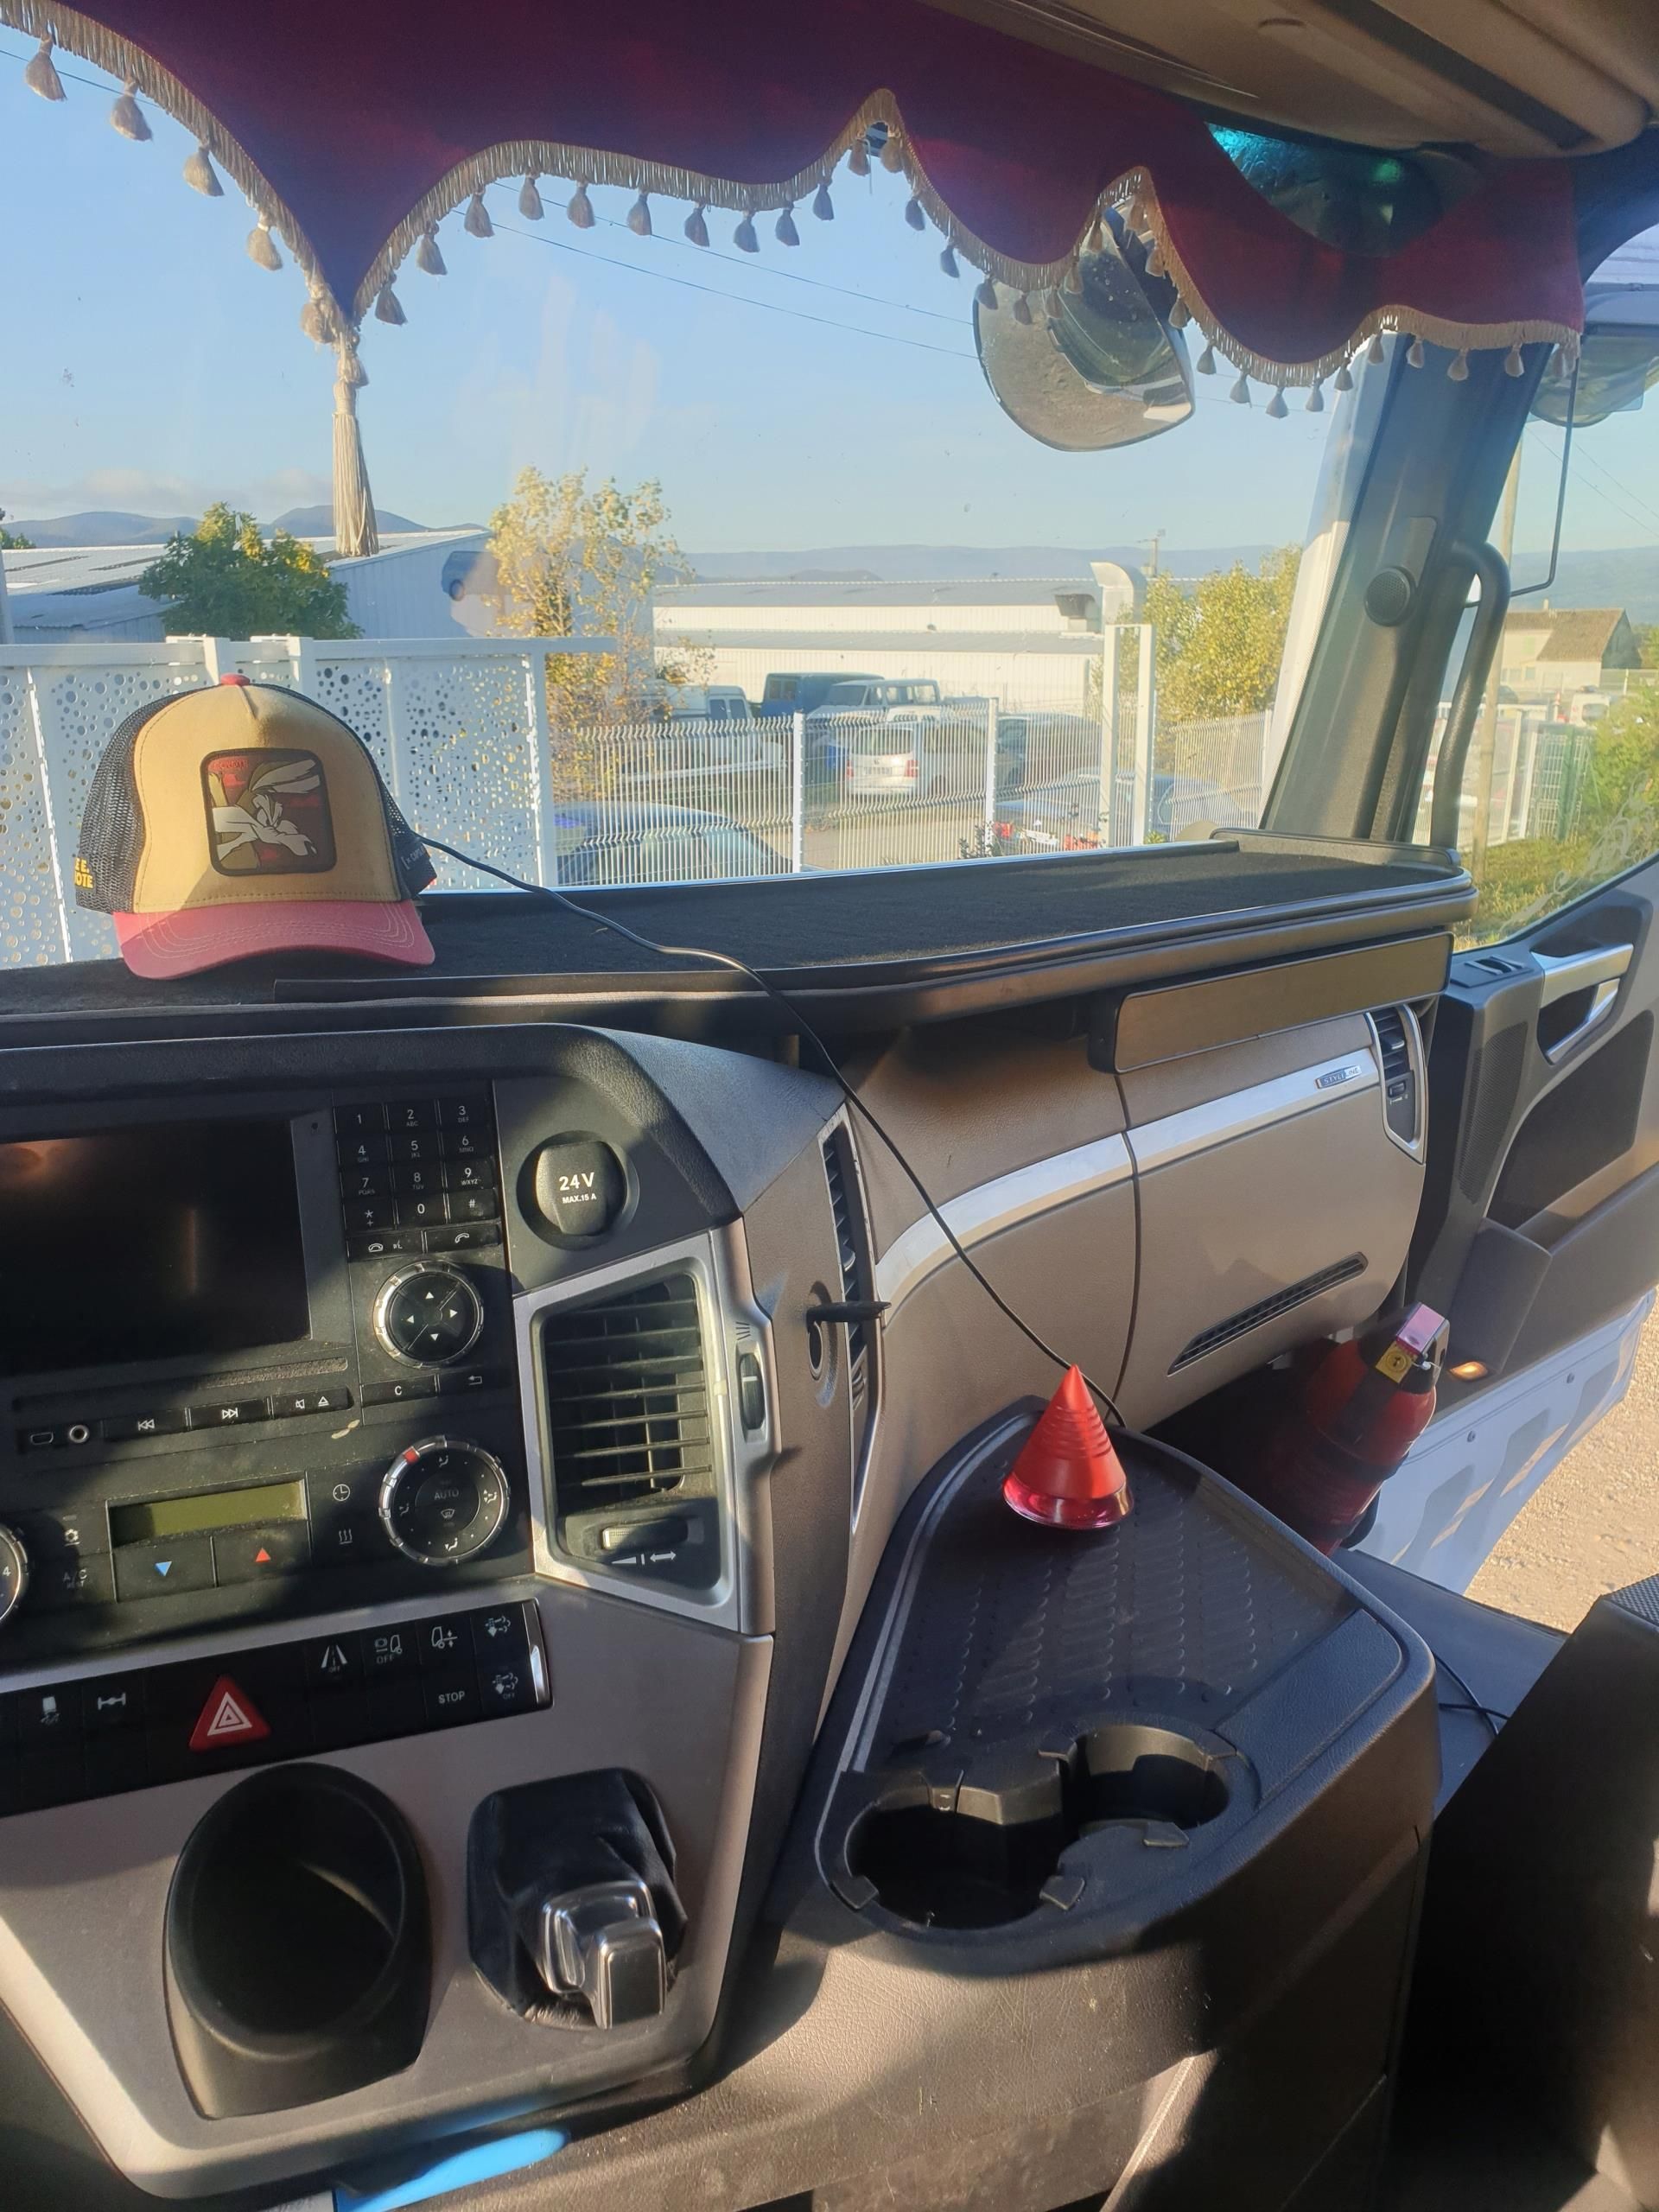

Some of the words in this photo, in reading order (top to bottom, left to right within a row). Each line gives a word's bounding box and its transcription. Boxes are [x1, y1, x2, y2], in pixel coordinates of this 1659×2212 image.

[406, 1109, 416, 1120] 2
[458, 1105, 467, 1116] 3
[356, 1113, 362, 1124] 1
[410, 1140, 419, 1151] 5
[461, 1135, 470, 1146] 6
[357, 1145, 366, 1156] 4
[413, 1172, 422, 1183] 8
[464, 1167, 473, 1179] 9
[361, 1177, 370, 1188] 7
[416, 1203, 426, 1214] 0
[394, 1385, 403, 1395] C
[434, 1488, 460, 1501] AUTO
[2, 1565, 12, 1577] 4
[376, 1653, 396, 1665] OFF
[438, 1690, 467, 1704] STOP
[502, 1692, 516, 1700] OFF
